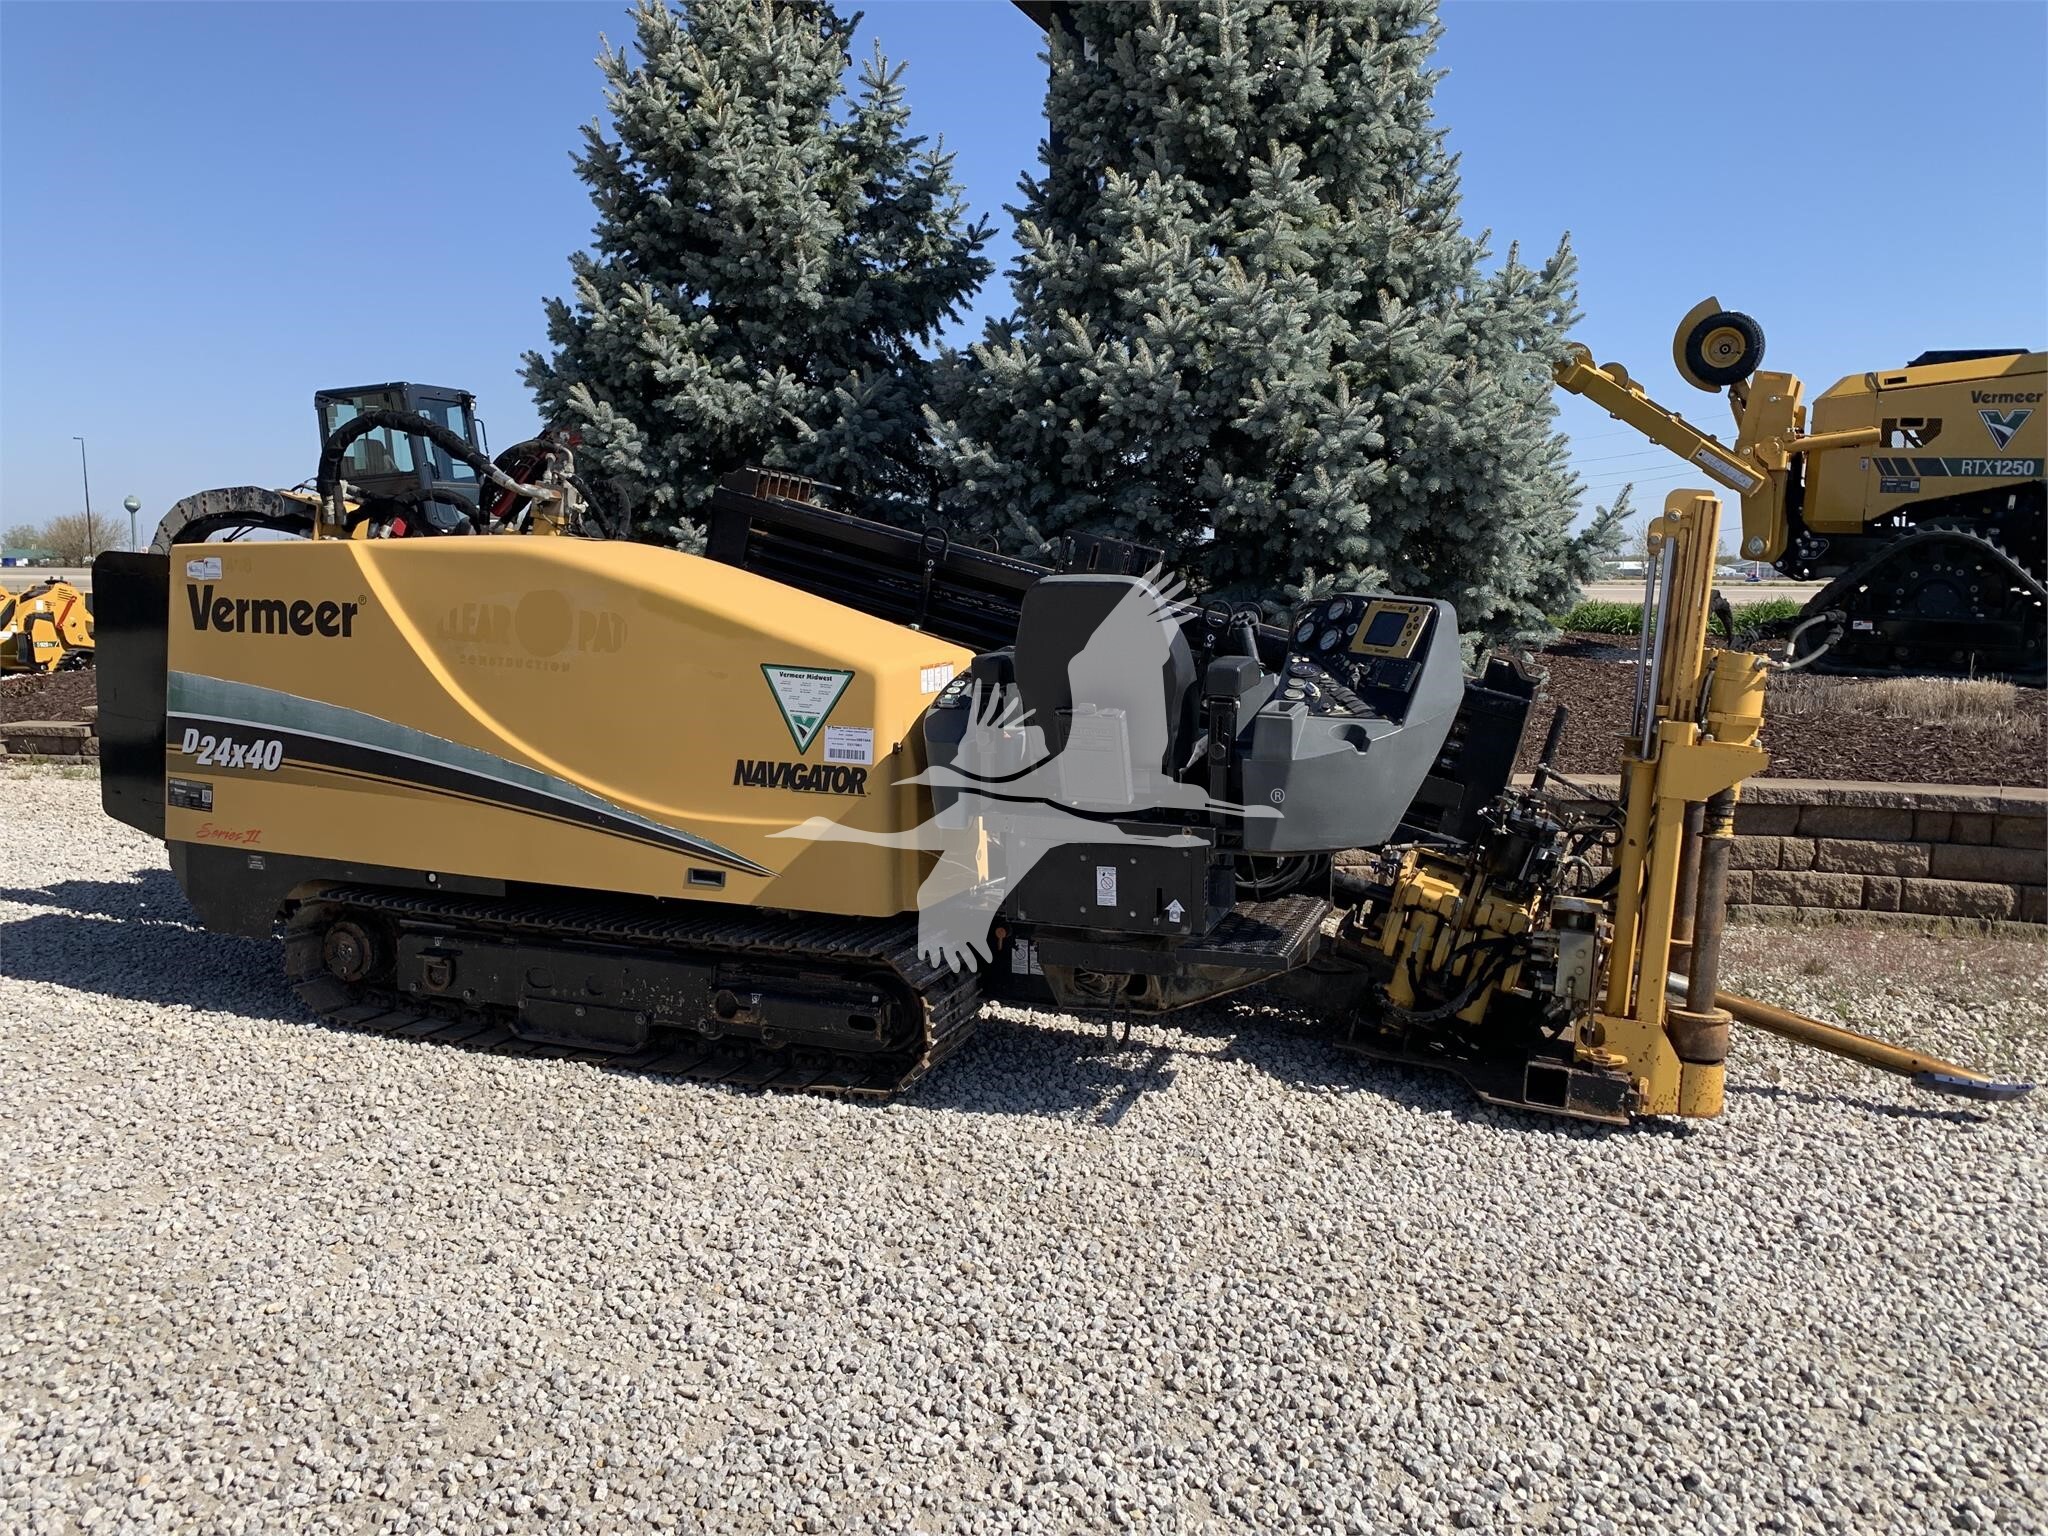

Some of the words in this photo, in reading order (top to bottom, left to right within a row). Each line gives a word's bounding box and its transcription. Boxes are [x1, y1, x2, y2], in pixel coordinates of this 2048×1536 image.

[1970, 390, 2043, 404] Vermeer
[1961, 460, 2035, 476] RTX1250
[186, 584, 358, 638] Vermeer
[779, 671, 805, 680] Vermeer
[181, 728, 284, 772] D24x40
[733, 759, 868, 795] NAVIGATOR
[196, 822, 242, 841] Series
[241, 829, 262, 844] II
